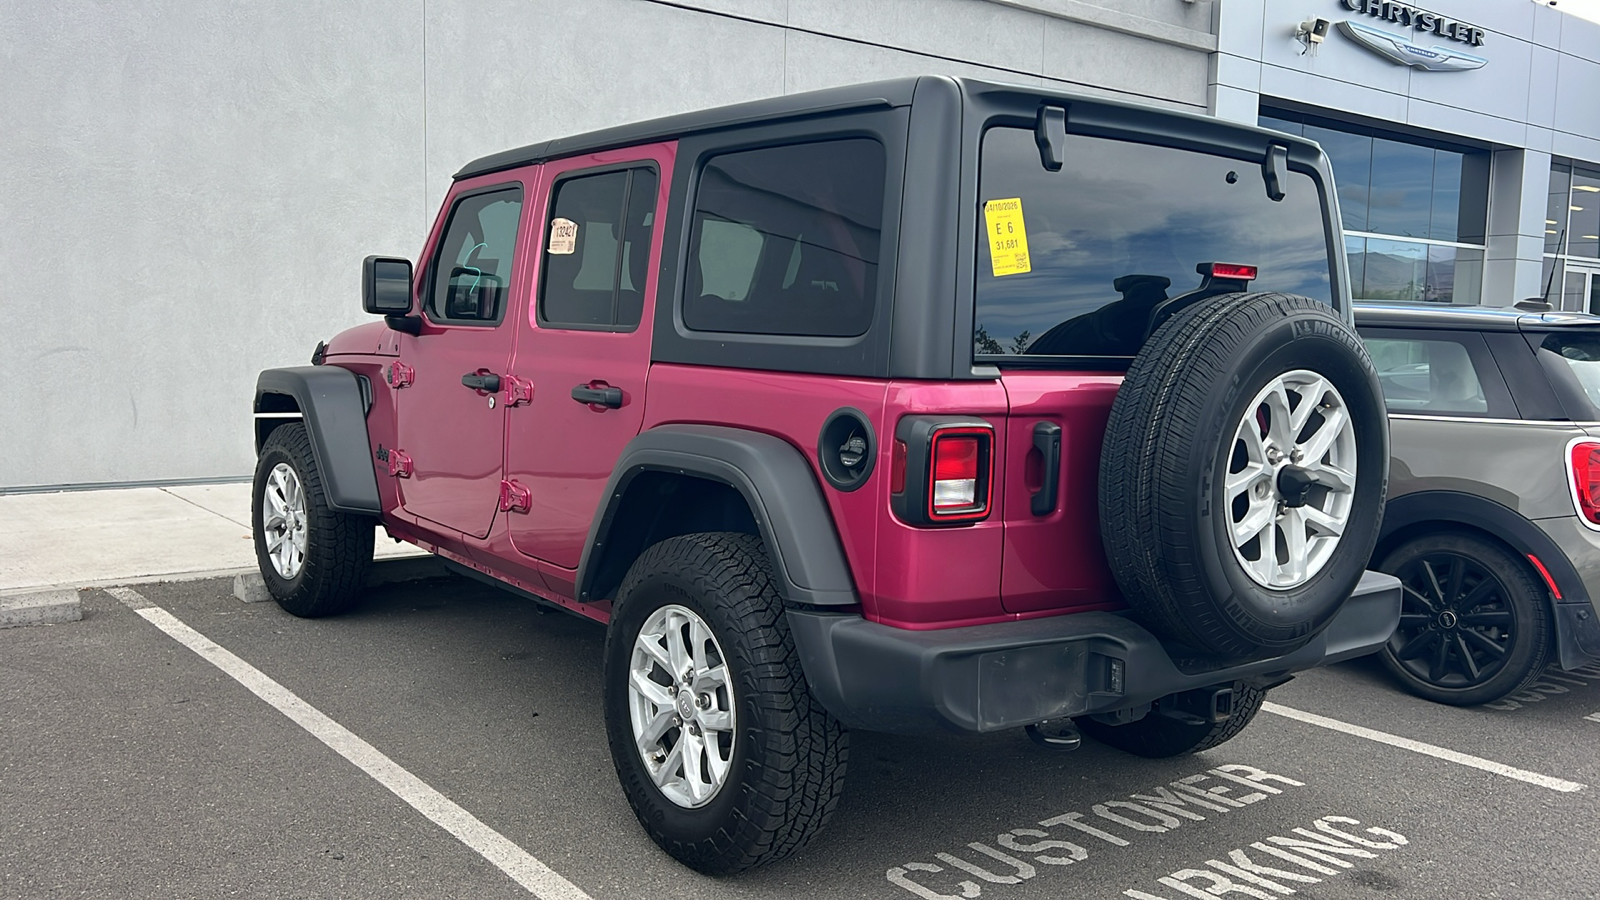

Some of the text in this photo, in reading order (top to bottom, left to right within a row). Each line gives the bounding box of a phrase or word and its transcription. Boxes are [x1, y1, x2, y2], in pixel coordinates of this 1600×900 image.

[1342, 0, 1485, 46] CHRYSLER
[996, 221, 1014, 235] E 6
[1313, 320, 1374, 377] MICHELIN
[886, 764, 1306, 900] CUSTOMER
[1122, 815, 1409, 900] RKING
